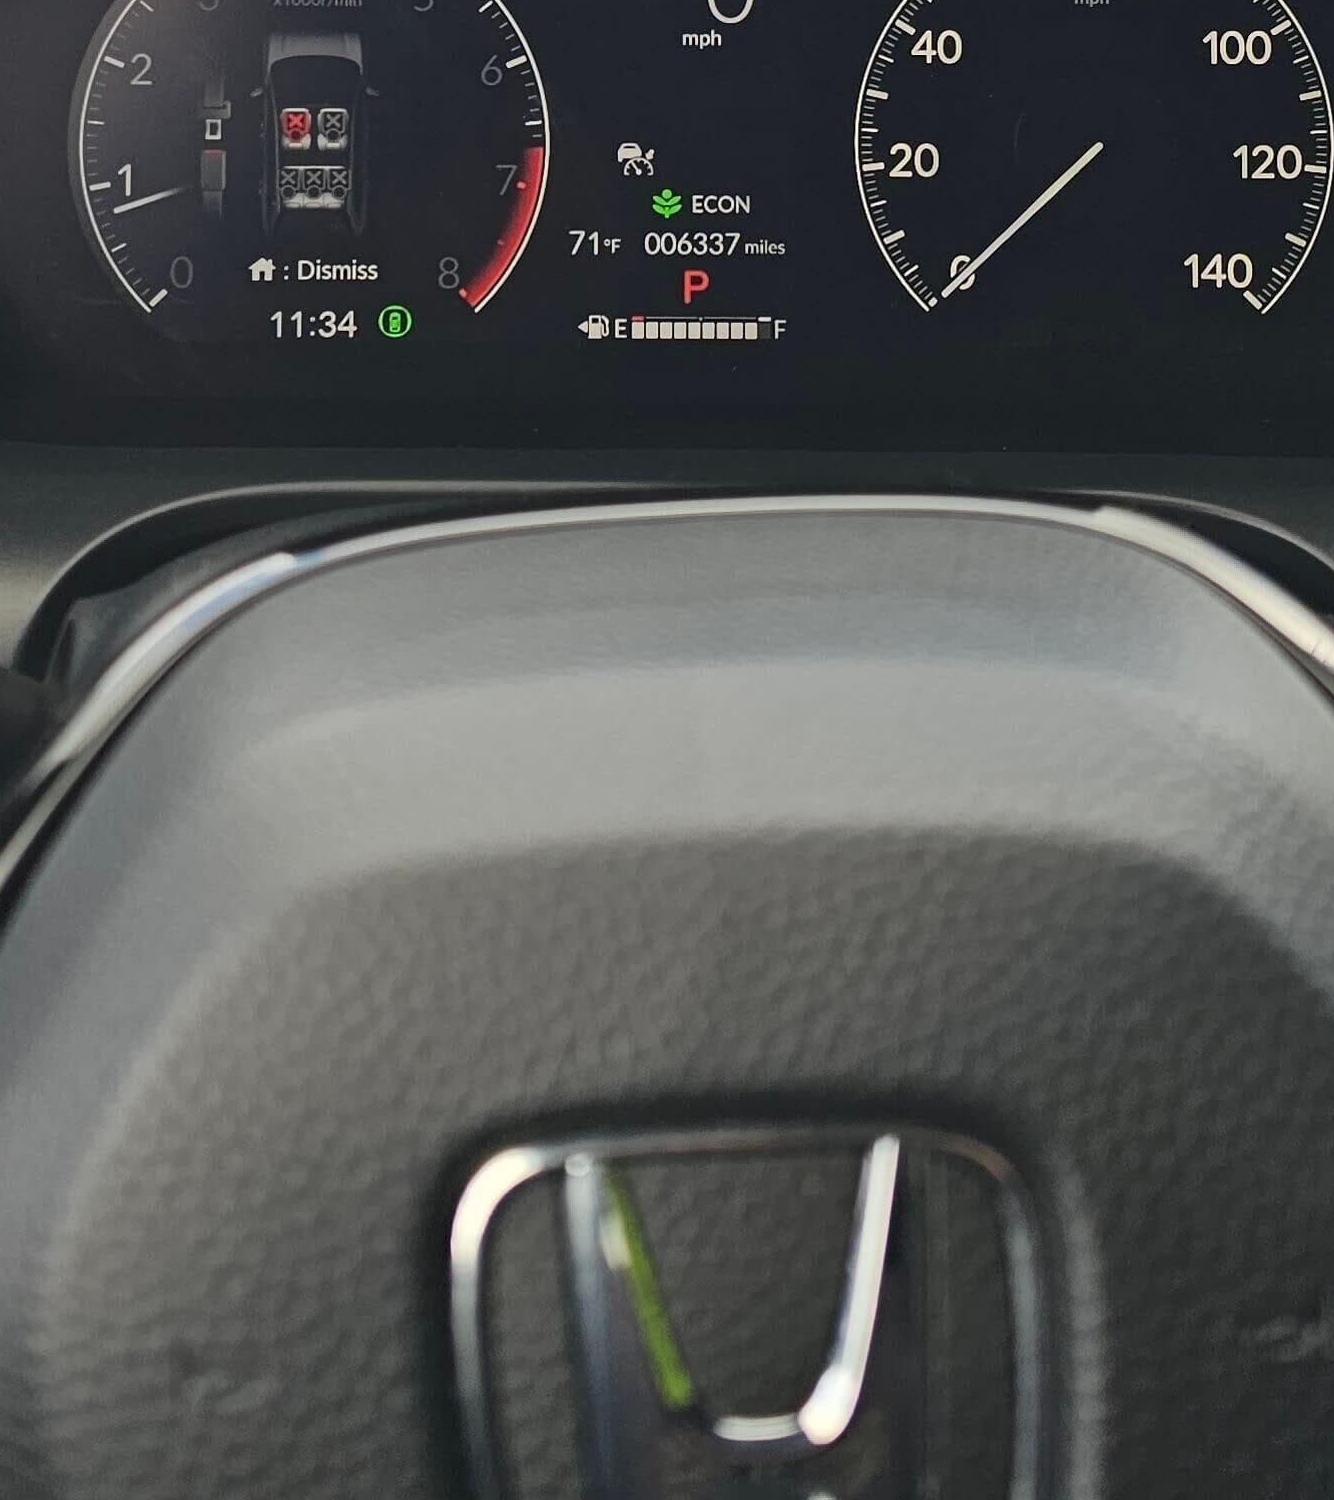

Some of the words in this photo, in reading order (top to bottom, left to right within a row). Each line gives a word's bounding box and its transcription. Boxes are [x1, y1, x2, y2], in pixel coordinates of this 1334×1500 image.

[681, 29, 723, 50] mph
[910, 29, 963, 65] 40
[1201, 29, 1272, 66] 100
[129, 54, 153, 86] 2
[480, 55, 504, 87] 6
[888, 142, 940, 178] 20
[1232, 143, 1304, 180] 120
[116, 163, 133, 197] 1
[495, 164, 518, 196] 7
[692, 194, 751, 215] ECON
[644, 231, 741, 256] 006337
[744, 238, 786, 255] miles
[170, 256, 194, 289] 0
[297, 259, 379, 282] Dismiss
[437, 257, 461, 290] 8
[683, 269, 710, 305] P
[948, 254, 977, 291] 0
[1182, 252, 1254, 289] 140
[269, 310, 358, 338] 11:34
[614, 318, 628, 339] E
[774, 319, 787, 339] F
